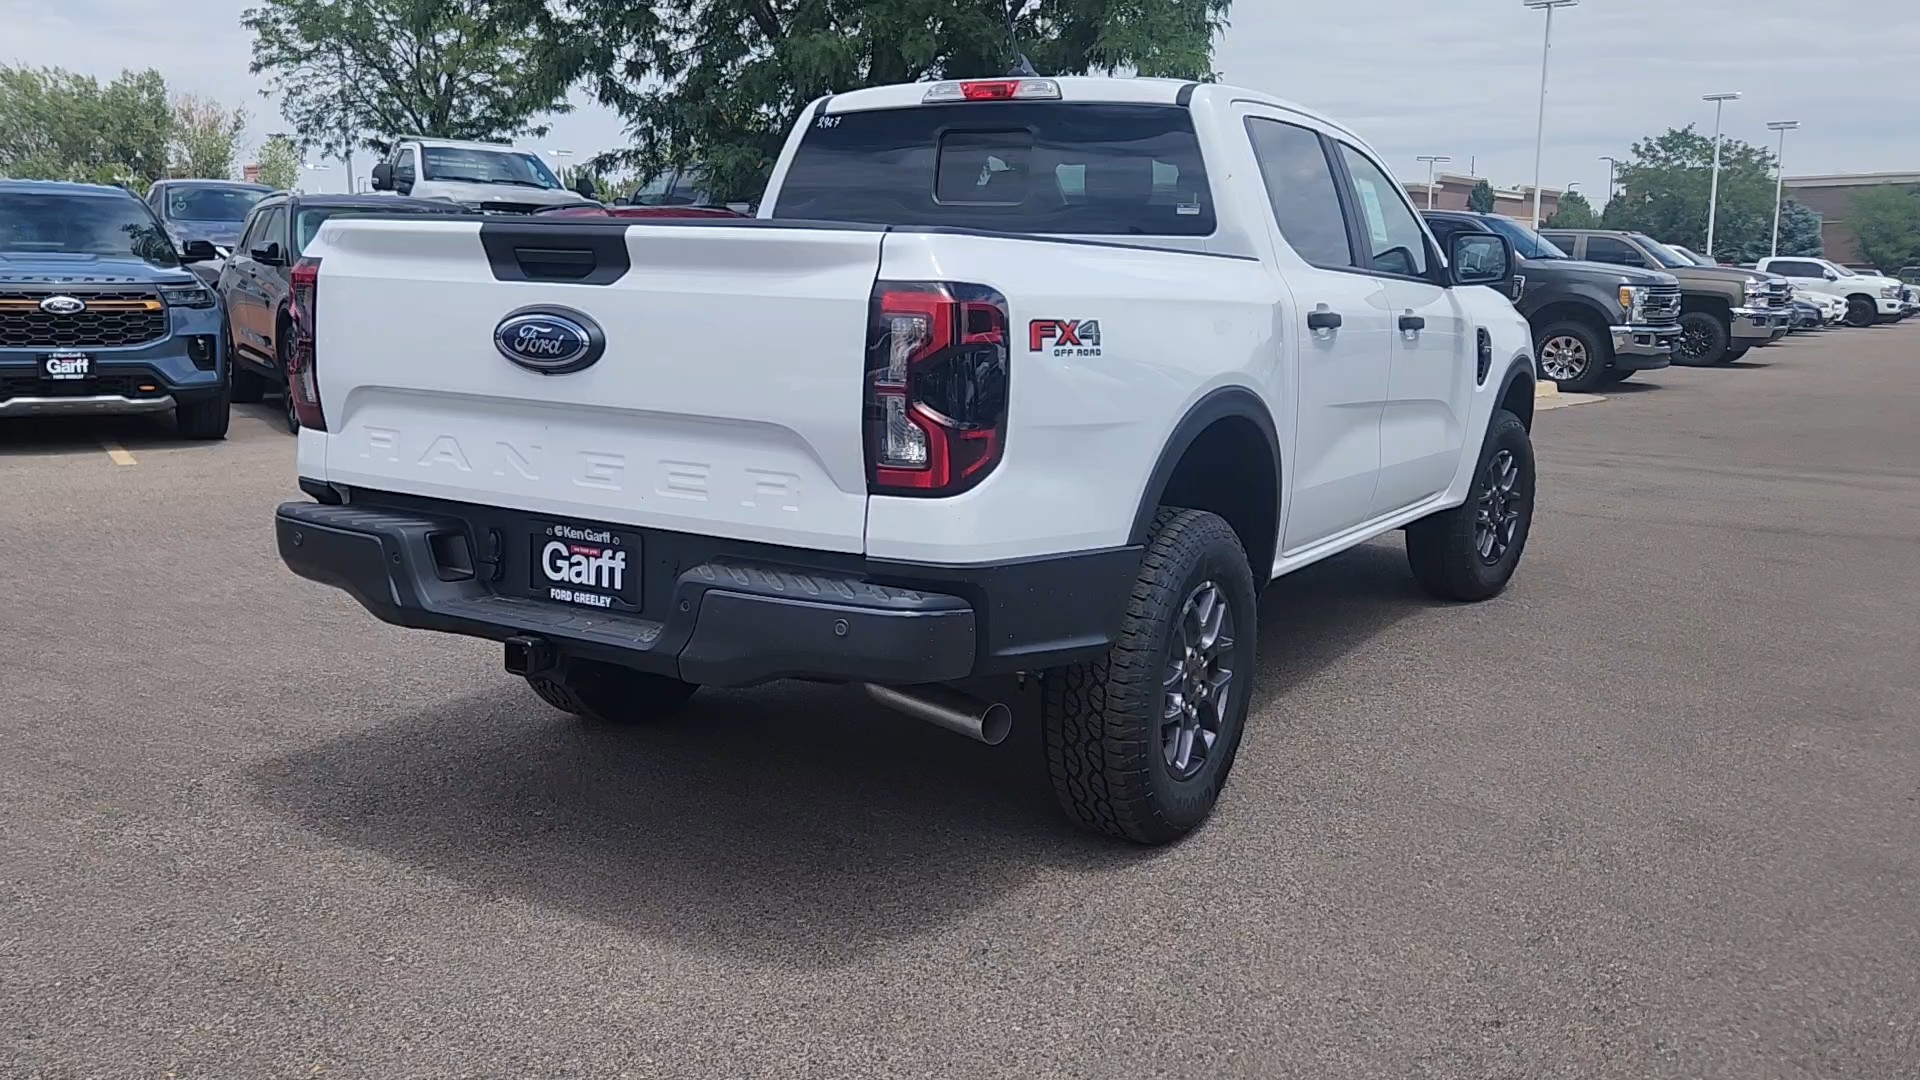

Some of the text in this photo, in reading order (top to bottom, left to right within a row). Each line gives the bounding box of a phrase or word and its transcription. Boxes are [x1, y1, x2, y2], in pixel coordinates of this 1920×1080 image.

[51, 301, 75, 310] Ford
[514, 324, 565, 354] Ford
[1029, 319, 1101, 352] FX4
[1053, 348, 1102, 357] OFF ROAD
[46, 358, 89, 374] Garff
[359, 425, 801, 512] RANGER
[563, 526, 611, 544] Ken Garff
[542, 541, 626, 590] Garff
[550, 588, 612, 608] FORD GREELEY
